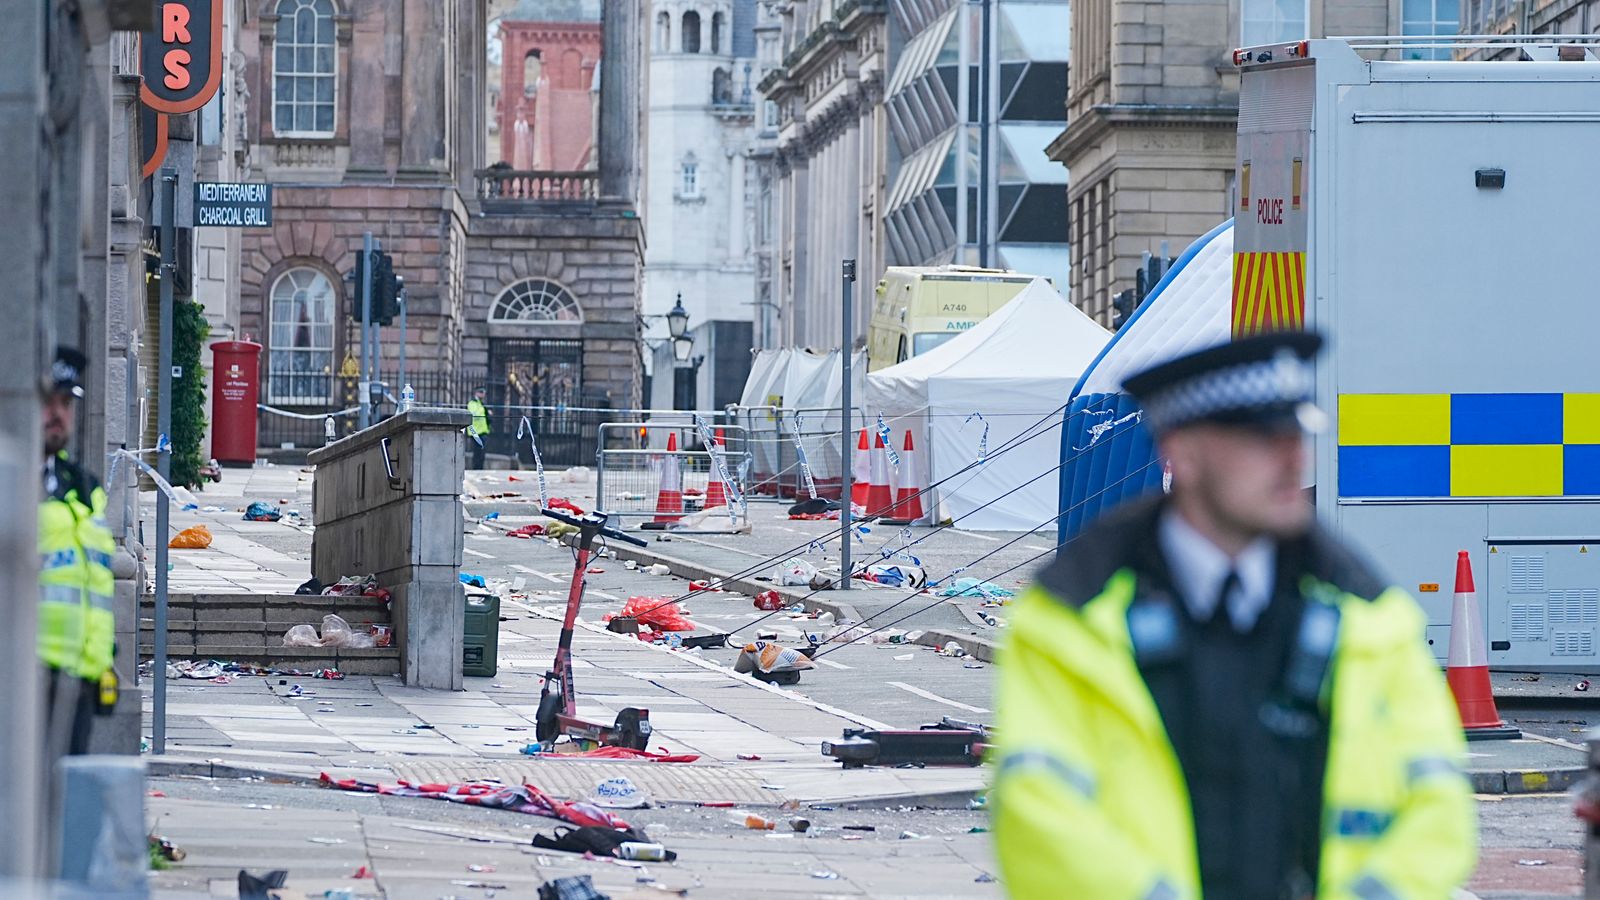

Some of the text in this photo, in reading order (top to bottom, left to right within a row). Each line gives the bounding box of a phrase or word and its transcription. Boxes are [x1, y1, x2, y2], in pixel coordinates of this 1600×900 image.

[199, 183, 267, 202] MEDITERRANEAN
[199, 207, 267, 226] CHARCOAL GRILL
[1257, 197, 1283, 225] POLICE
[942, 303, 967, 312] A740
